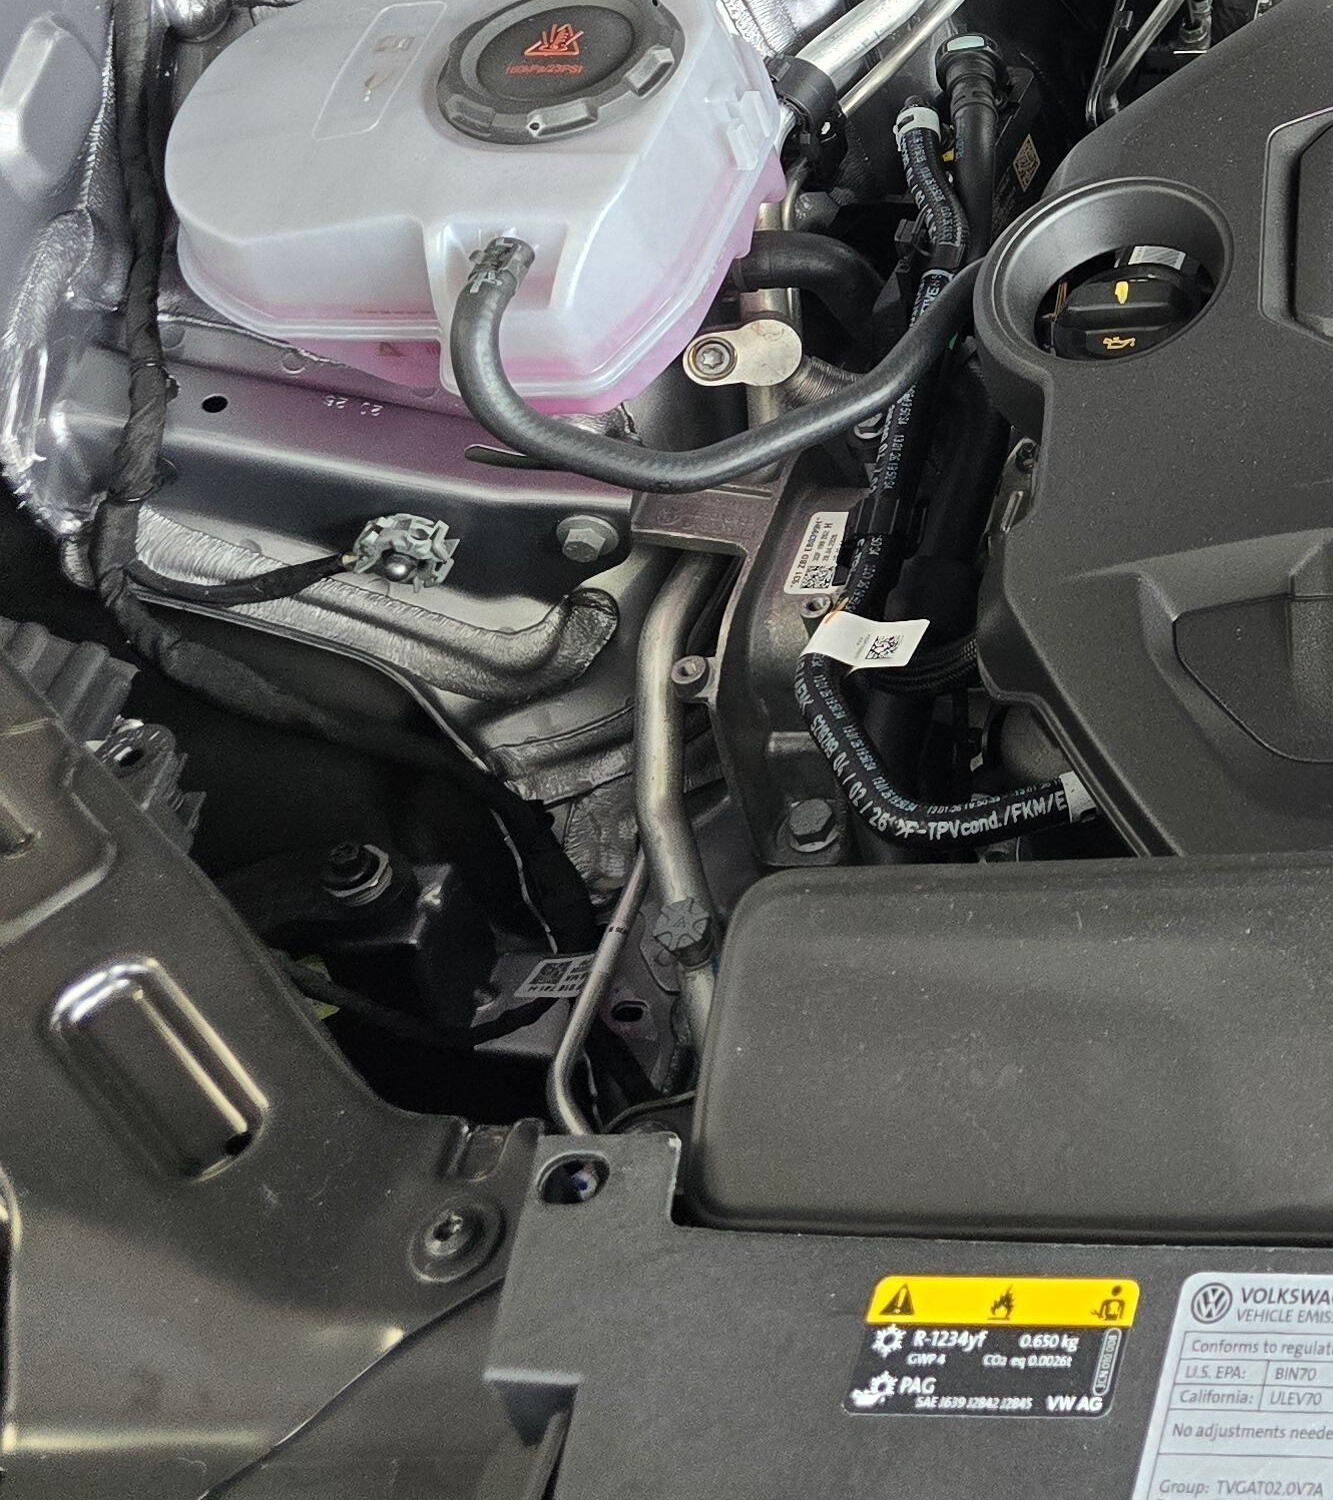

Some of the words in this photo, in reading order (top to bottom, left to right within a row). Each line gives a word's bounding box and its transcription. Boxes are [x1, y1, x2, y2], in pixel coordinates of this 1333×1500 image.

[1236, 1308, 1293, 1323] VEHICLE
[913, 1330, 988, 1352] R-1234yf
[1019, 1334, 1059, 1349] 0.650
[1061, 1335, 1080, 1352] kg
[1192, 1339, 1259, 1353] Conforms
[1263, 1340, 1277, 1353] to
[906, 1353, 936, 1366] GWP
[937, 1354, 947, 1366] 4
[1027, 1355, 1073, 1368] 0.0026t
[1275, 1367, 1317, 1380] BIN70
[900, 1377, 936, 1395] PAG
[915, 1396, 937, 1409] SAE
[1046, 1395, 1076, 1411] VW
[1076, 1396, 1103, 1411] AG
[1180, 1390, 1253, 1404] California:
[1270, 1391, 1322, 1406] ULEV70
[1172, 1424, 1192, 1437] No
[1195, 1423, 1286, 1441] adjustments
[1159, 1480, 1210, 1495] Group:
